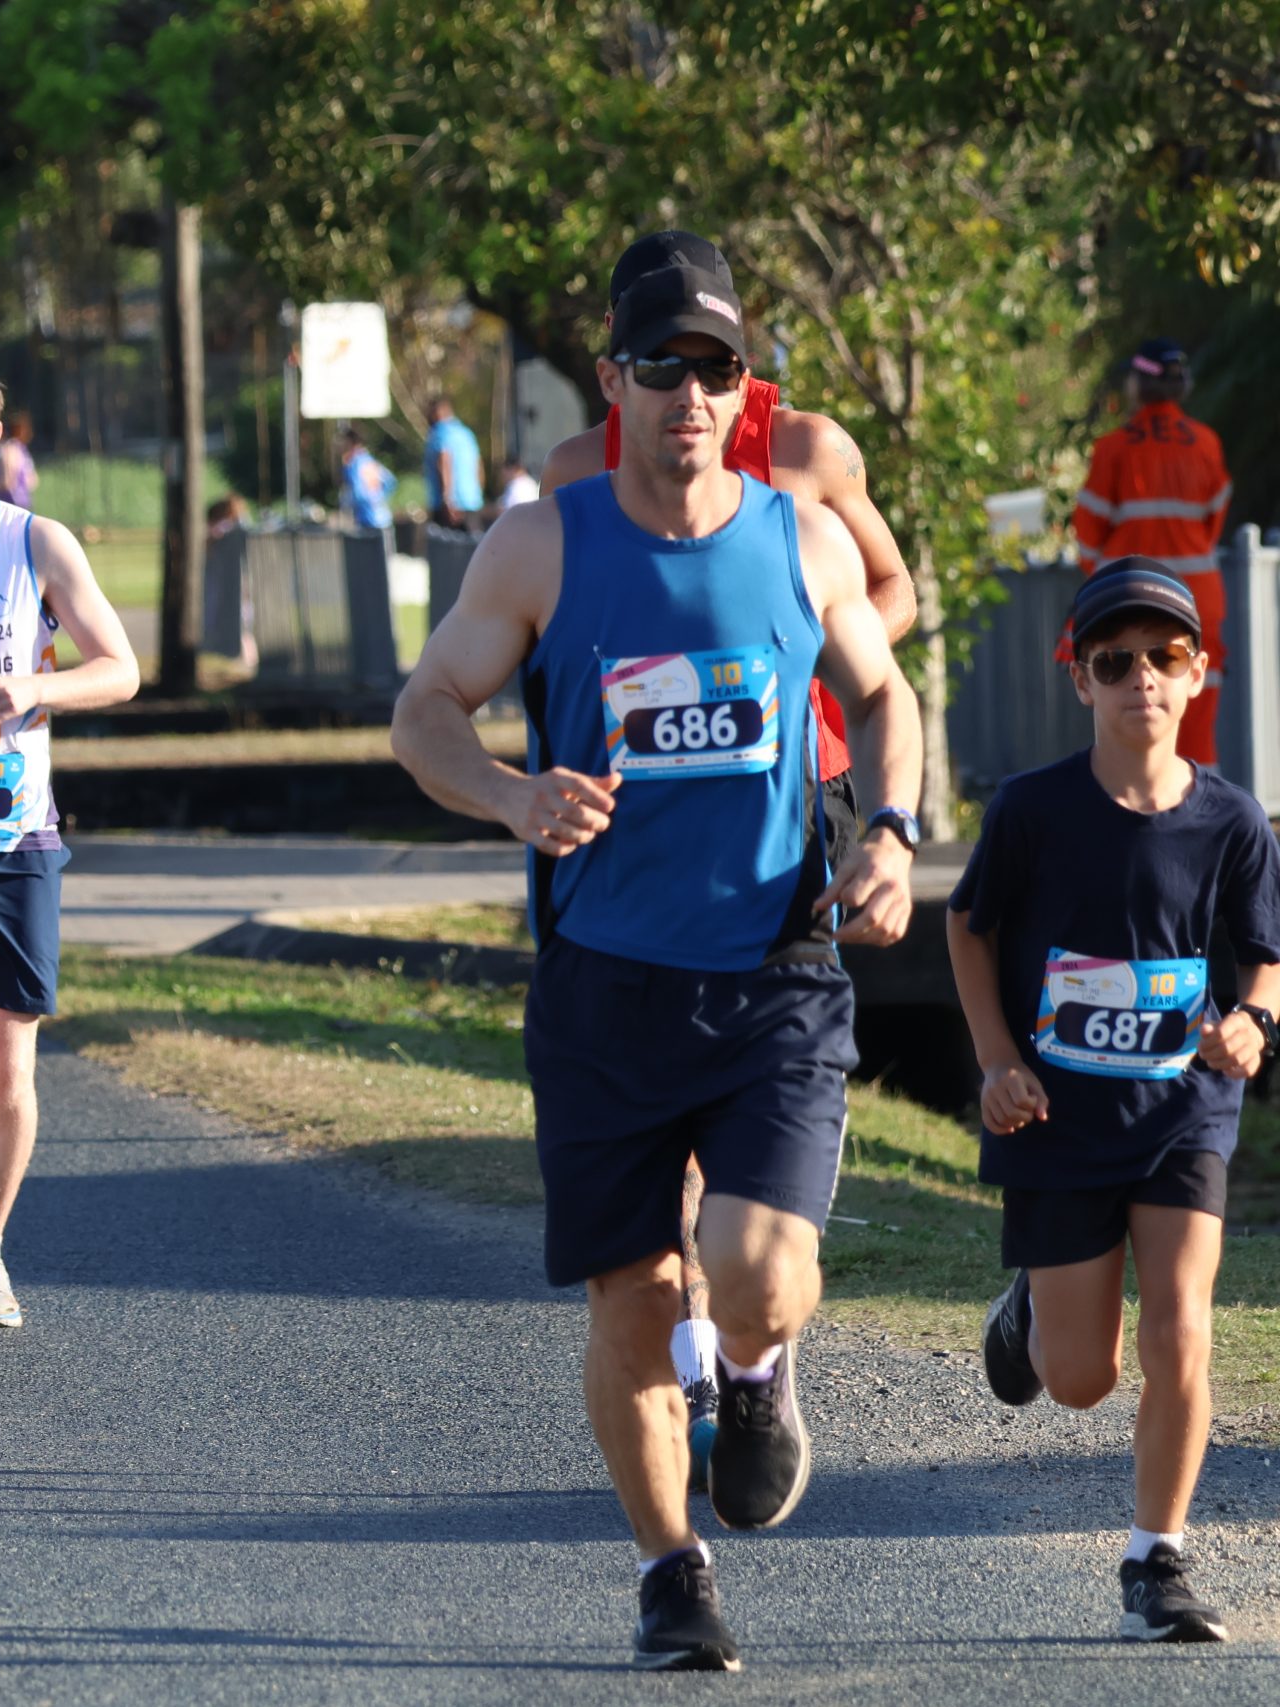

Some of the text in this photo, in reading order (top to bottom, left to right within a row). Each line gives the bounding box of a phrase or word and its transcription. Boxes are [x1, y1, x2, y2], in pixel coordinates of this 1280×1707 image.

[1124, 415, 1196, 446] SES
[710, 662, 743, 686] 10
[706, 683, 750, 699] YEARS
[653, 703, 738, 752] 686
[1149, 974, 1176, 996] 10
[1142, 995, 1180, 1008] YEARS
[1084, 1010, 1162, 1052] 687
